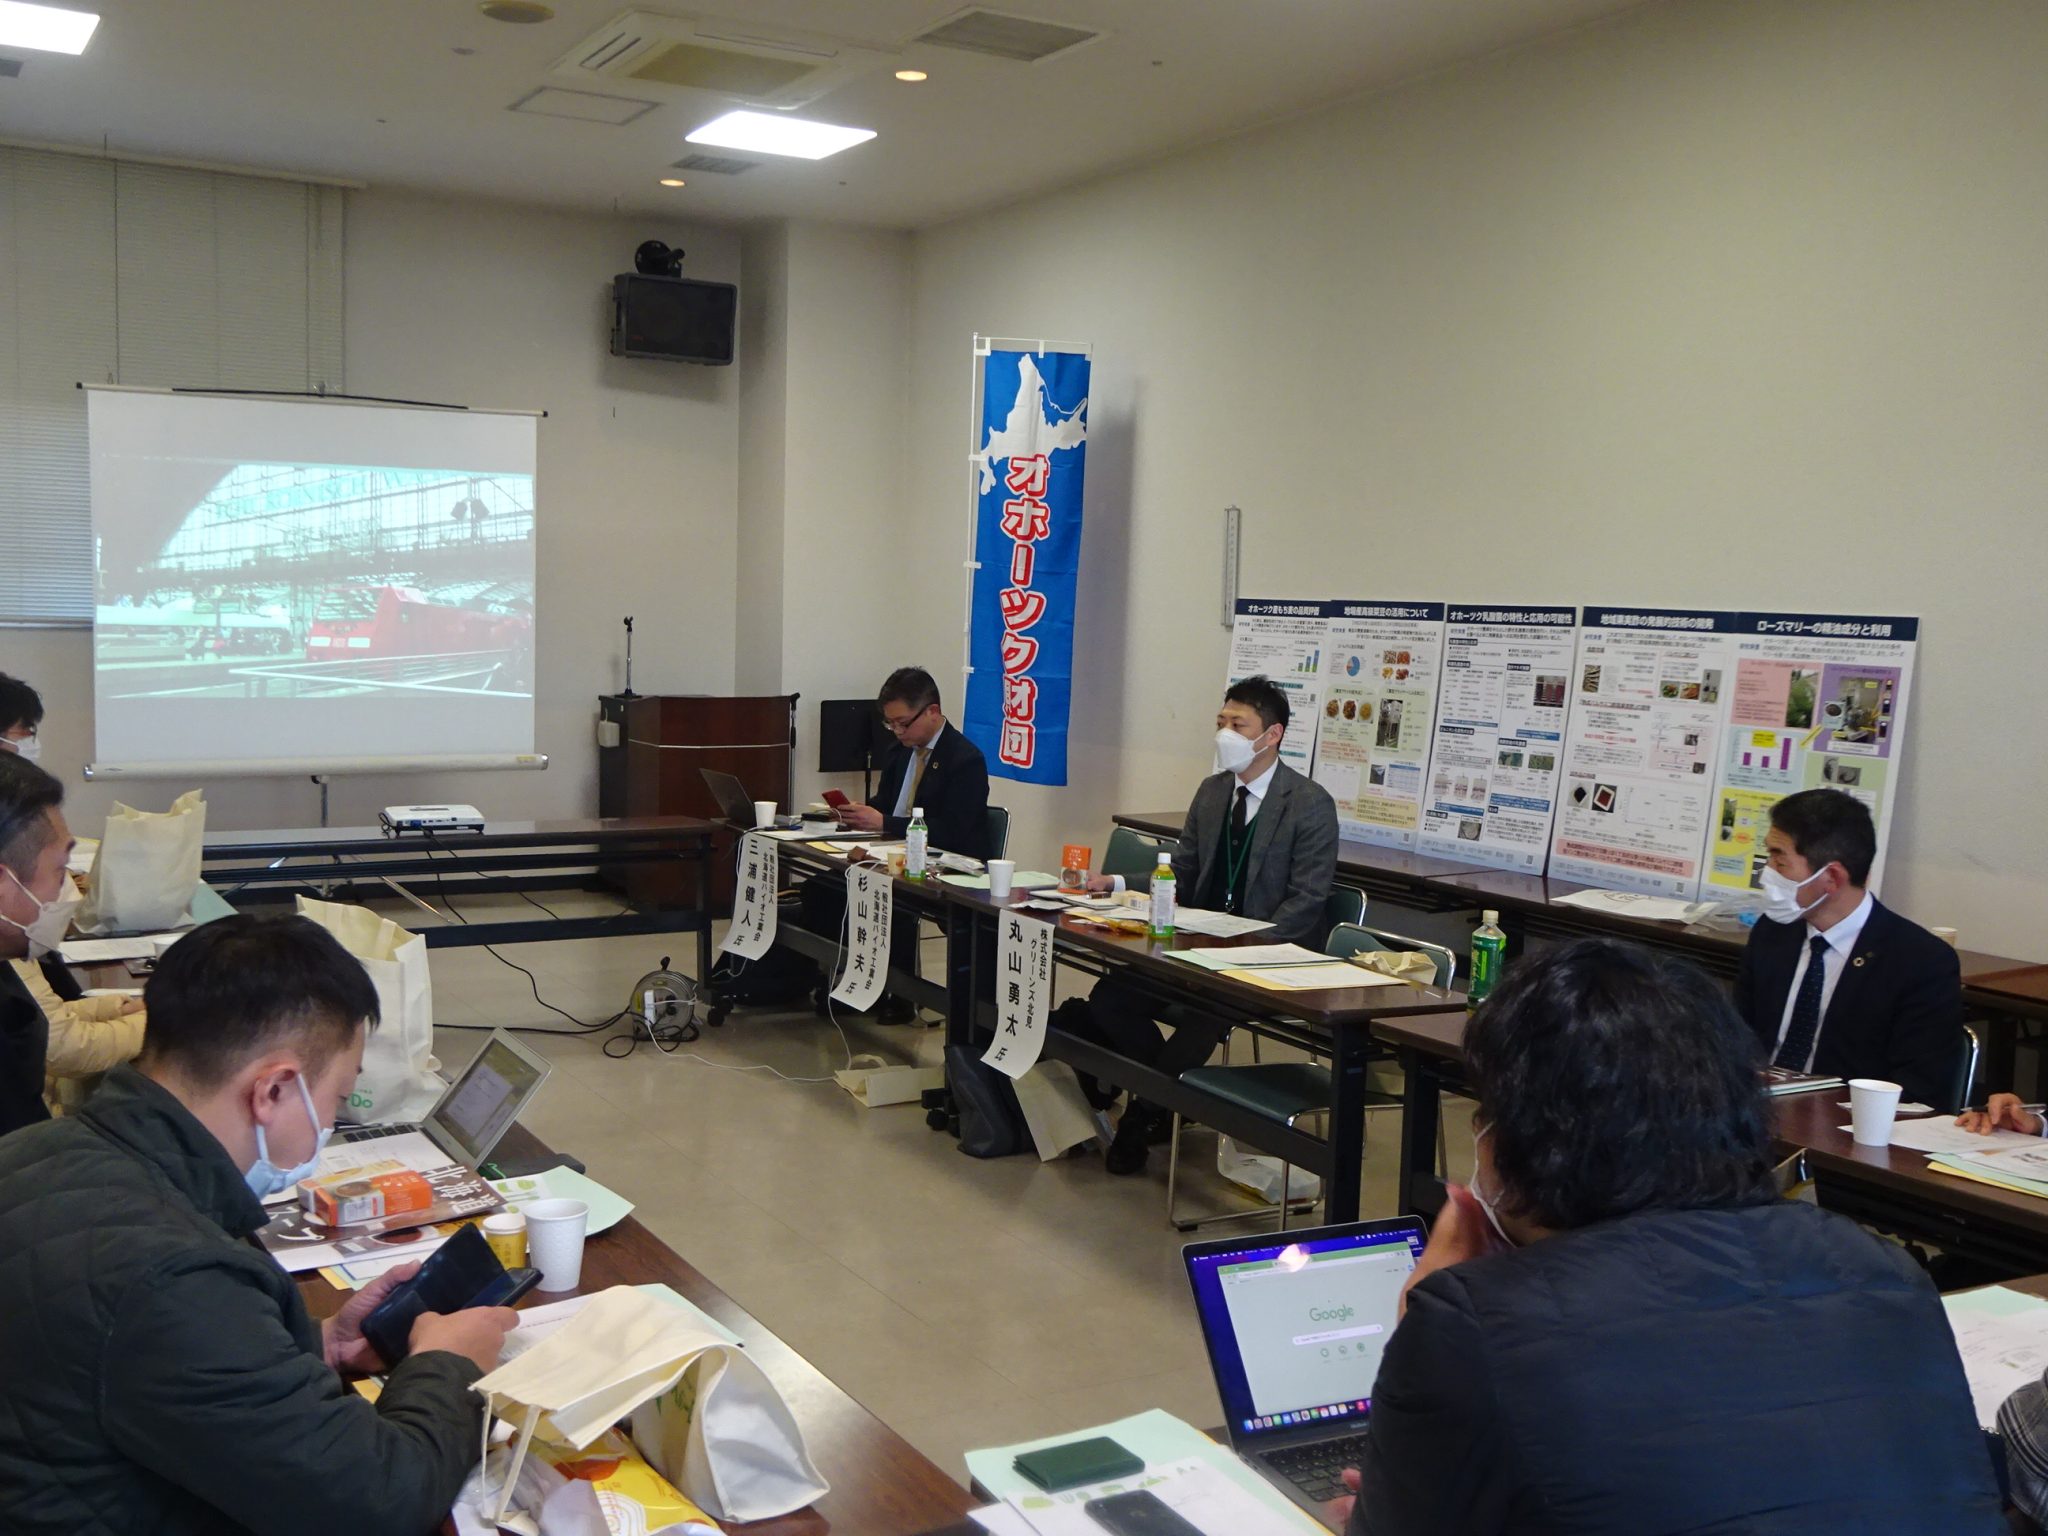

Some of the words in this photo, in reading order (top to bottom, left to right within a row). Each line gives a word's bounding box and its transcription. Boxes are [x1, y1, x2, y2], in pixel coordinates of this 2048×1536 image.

[1000, 453, 1051, 769] オホーツク財団
[1450, 611, 1573, 624] オホーツク乳酸菌の特性と応用の可能性
[1039, 928, 1048, 981] 株式会社
[1025, 938, 1038, 1029] グリーンズ北見
[421, 1165, 499, 1214] 北海道
[1309, 1304, 1354, 1322] Google
